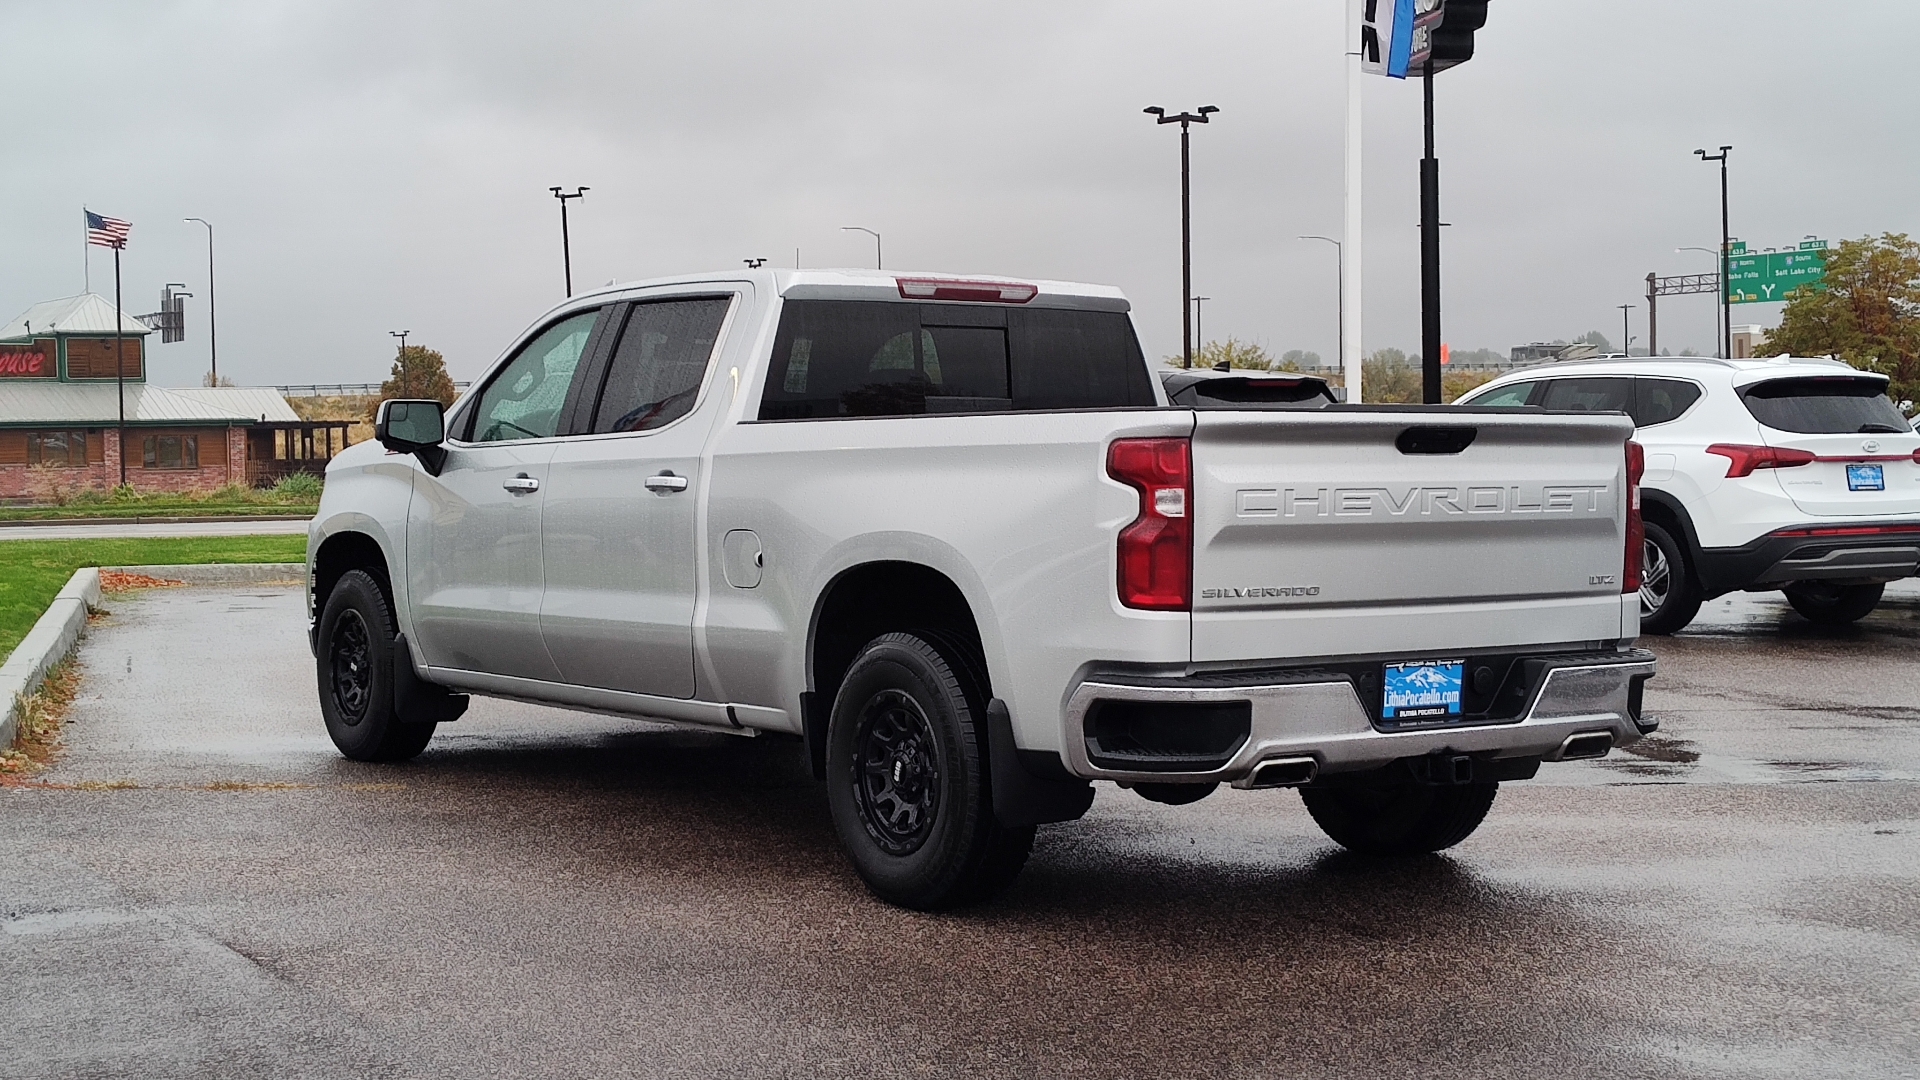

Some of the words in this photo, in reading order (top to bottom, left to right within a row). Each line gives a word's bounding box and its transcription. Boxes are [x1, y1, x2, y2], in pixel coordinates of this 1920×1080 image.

[1743, 271, 1759, 279] Falls
[1807, 266, 1821, 275] City
[1235, 485, 1608, 518] CHEVROLET
[1589, 575, 1615, 585] LTZ
[1202, 586, 1320, 599] SILVERADO
[1384, 688, 1459, 707] LithiaPocatello.com
